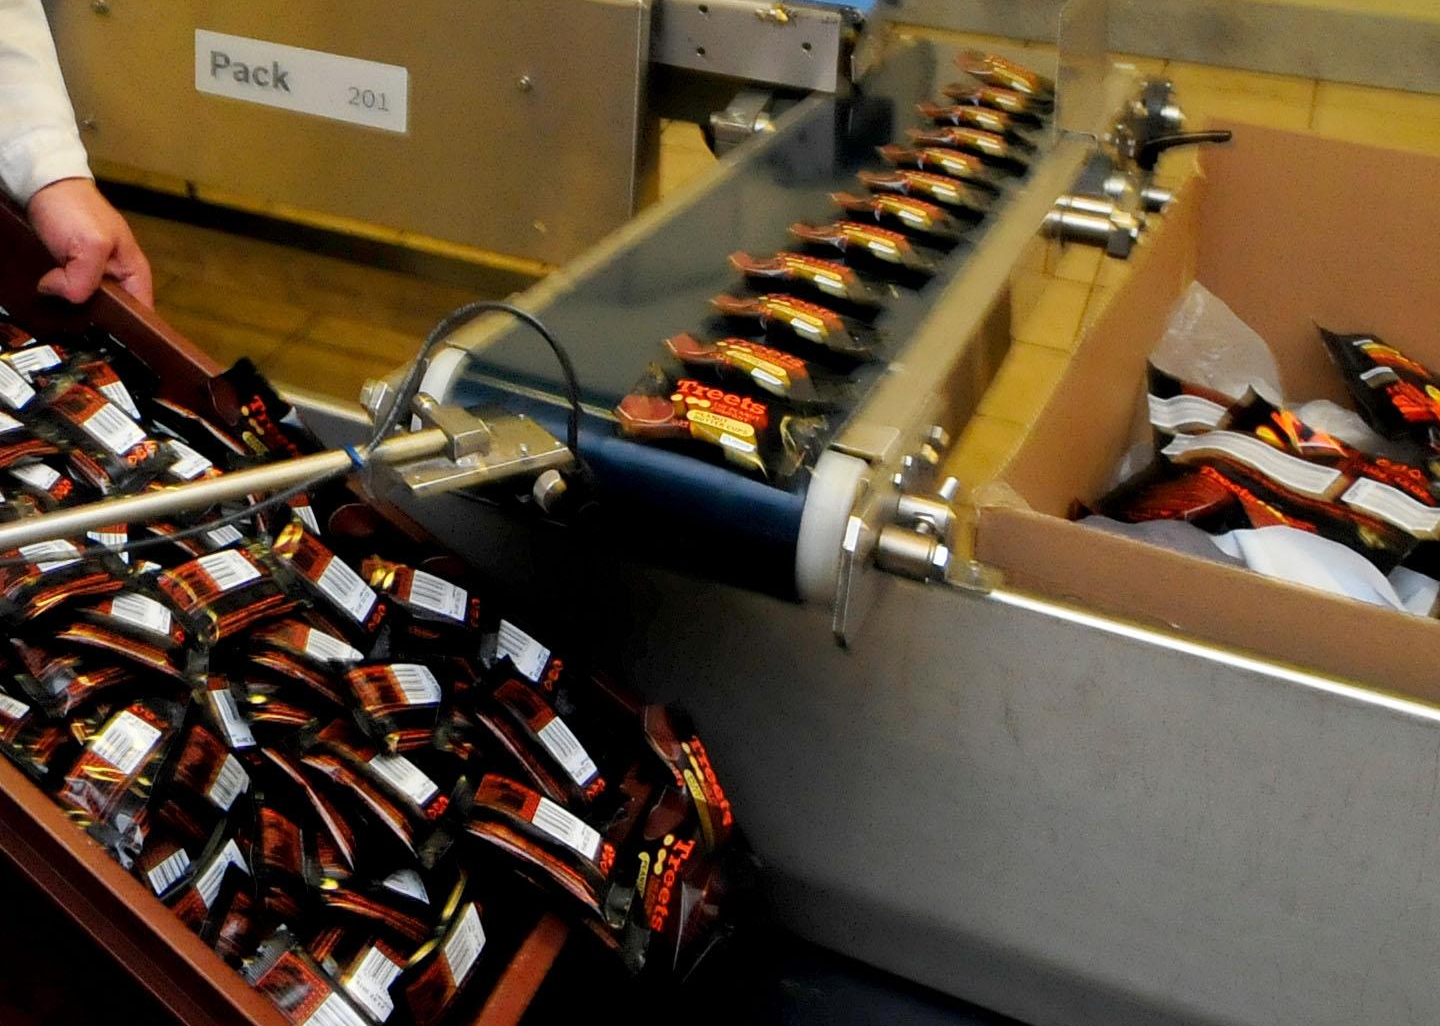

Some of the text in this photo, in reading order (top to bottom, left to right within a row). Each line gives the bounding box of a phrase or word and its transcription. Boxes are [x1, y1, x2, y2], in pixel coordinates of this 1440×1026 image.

[210, 50, 389, 112] Pack 201
[677, 379, 767, 415] Treets
[650, 840, 696, 932] Treets
